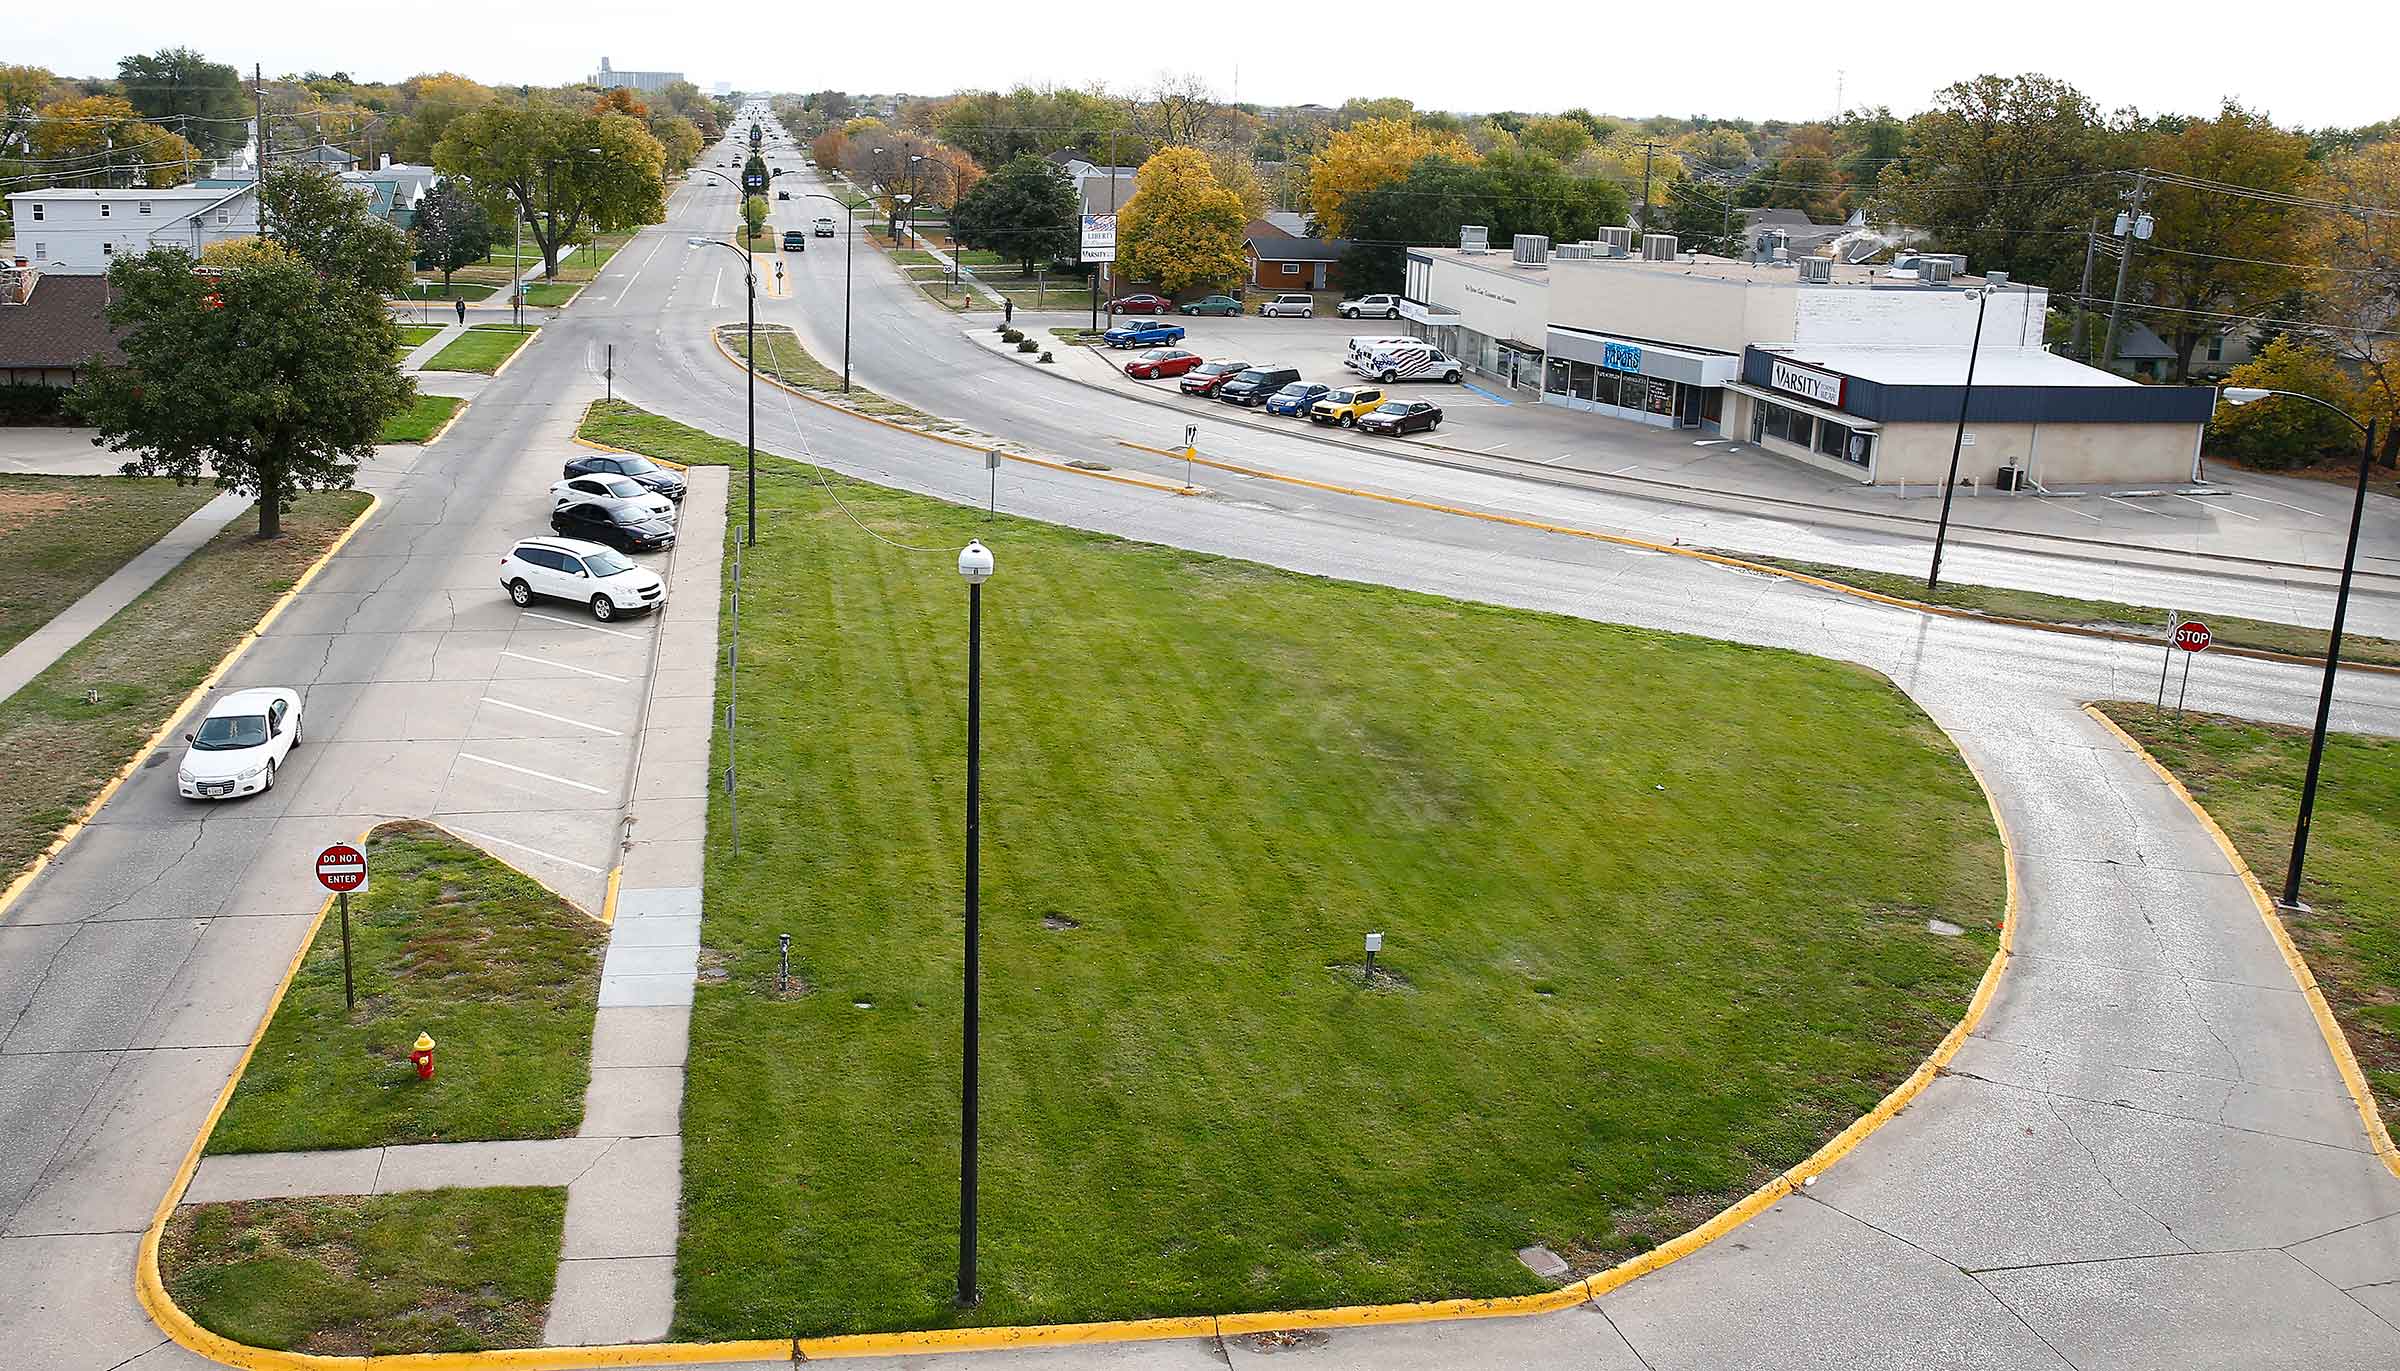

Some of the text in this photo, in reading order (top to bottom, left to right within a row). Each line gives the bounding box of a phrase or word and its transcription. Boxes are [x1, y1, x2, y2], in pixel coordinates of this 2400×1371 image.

[1087, 232, 1113, 240] LIBERTY
[1082, 250, 1106, 258] VARSITY
[1776, 364, 1822, 397] VARSITY
[2176, 629, 2209, 644] STOP
[323, 854, 358, 863] DO NOT
[327, 875, 357, 884] ENTER
